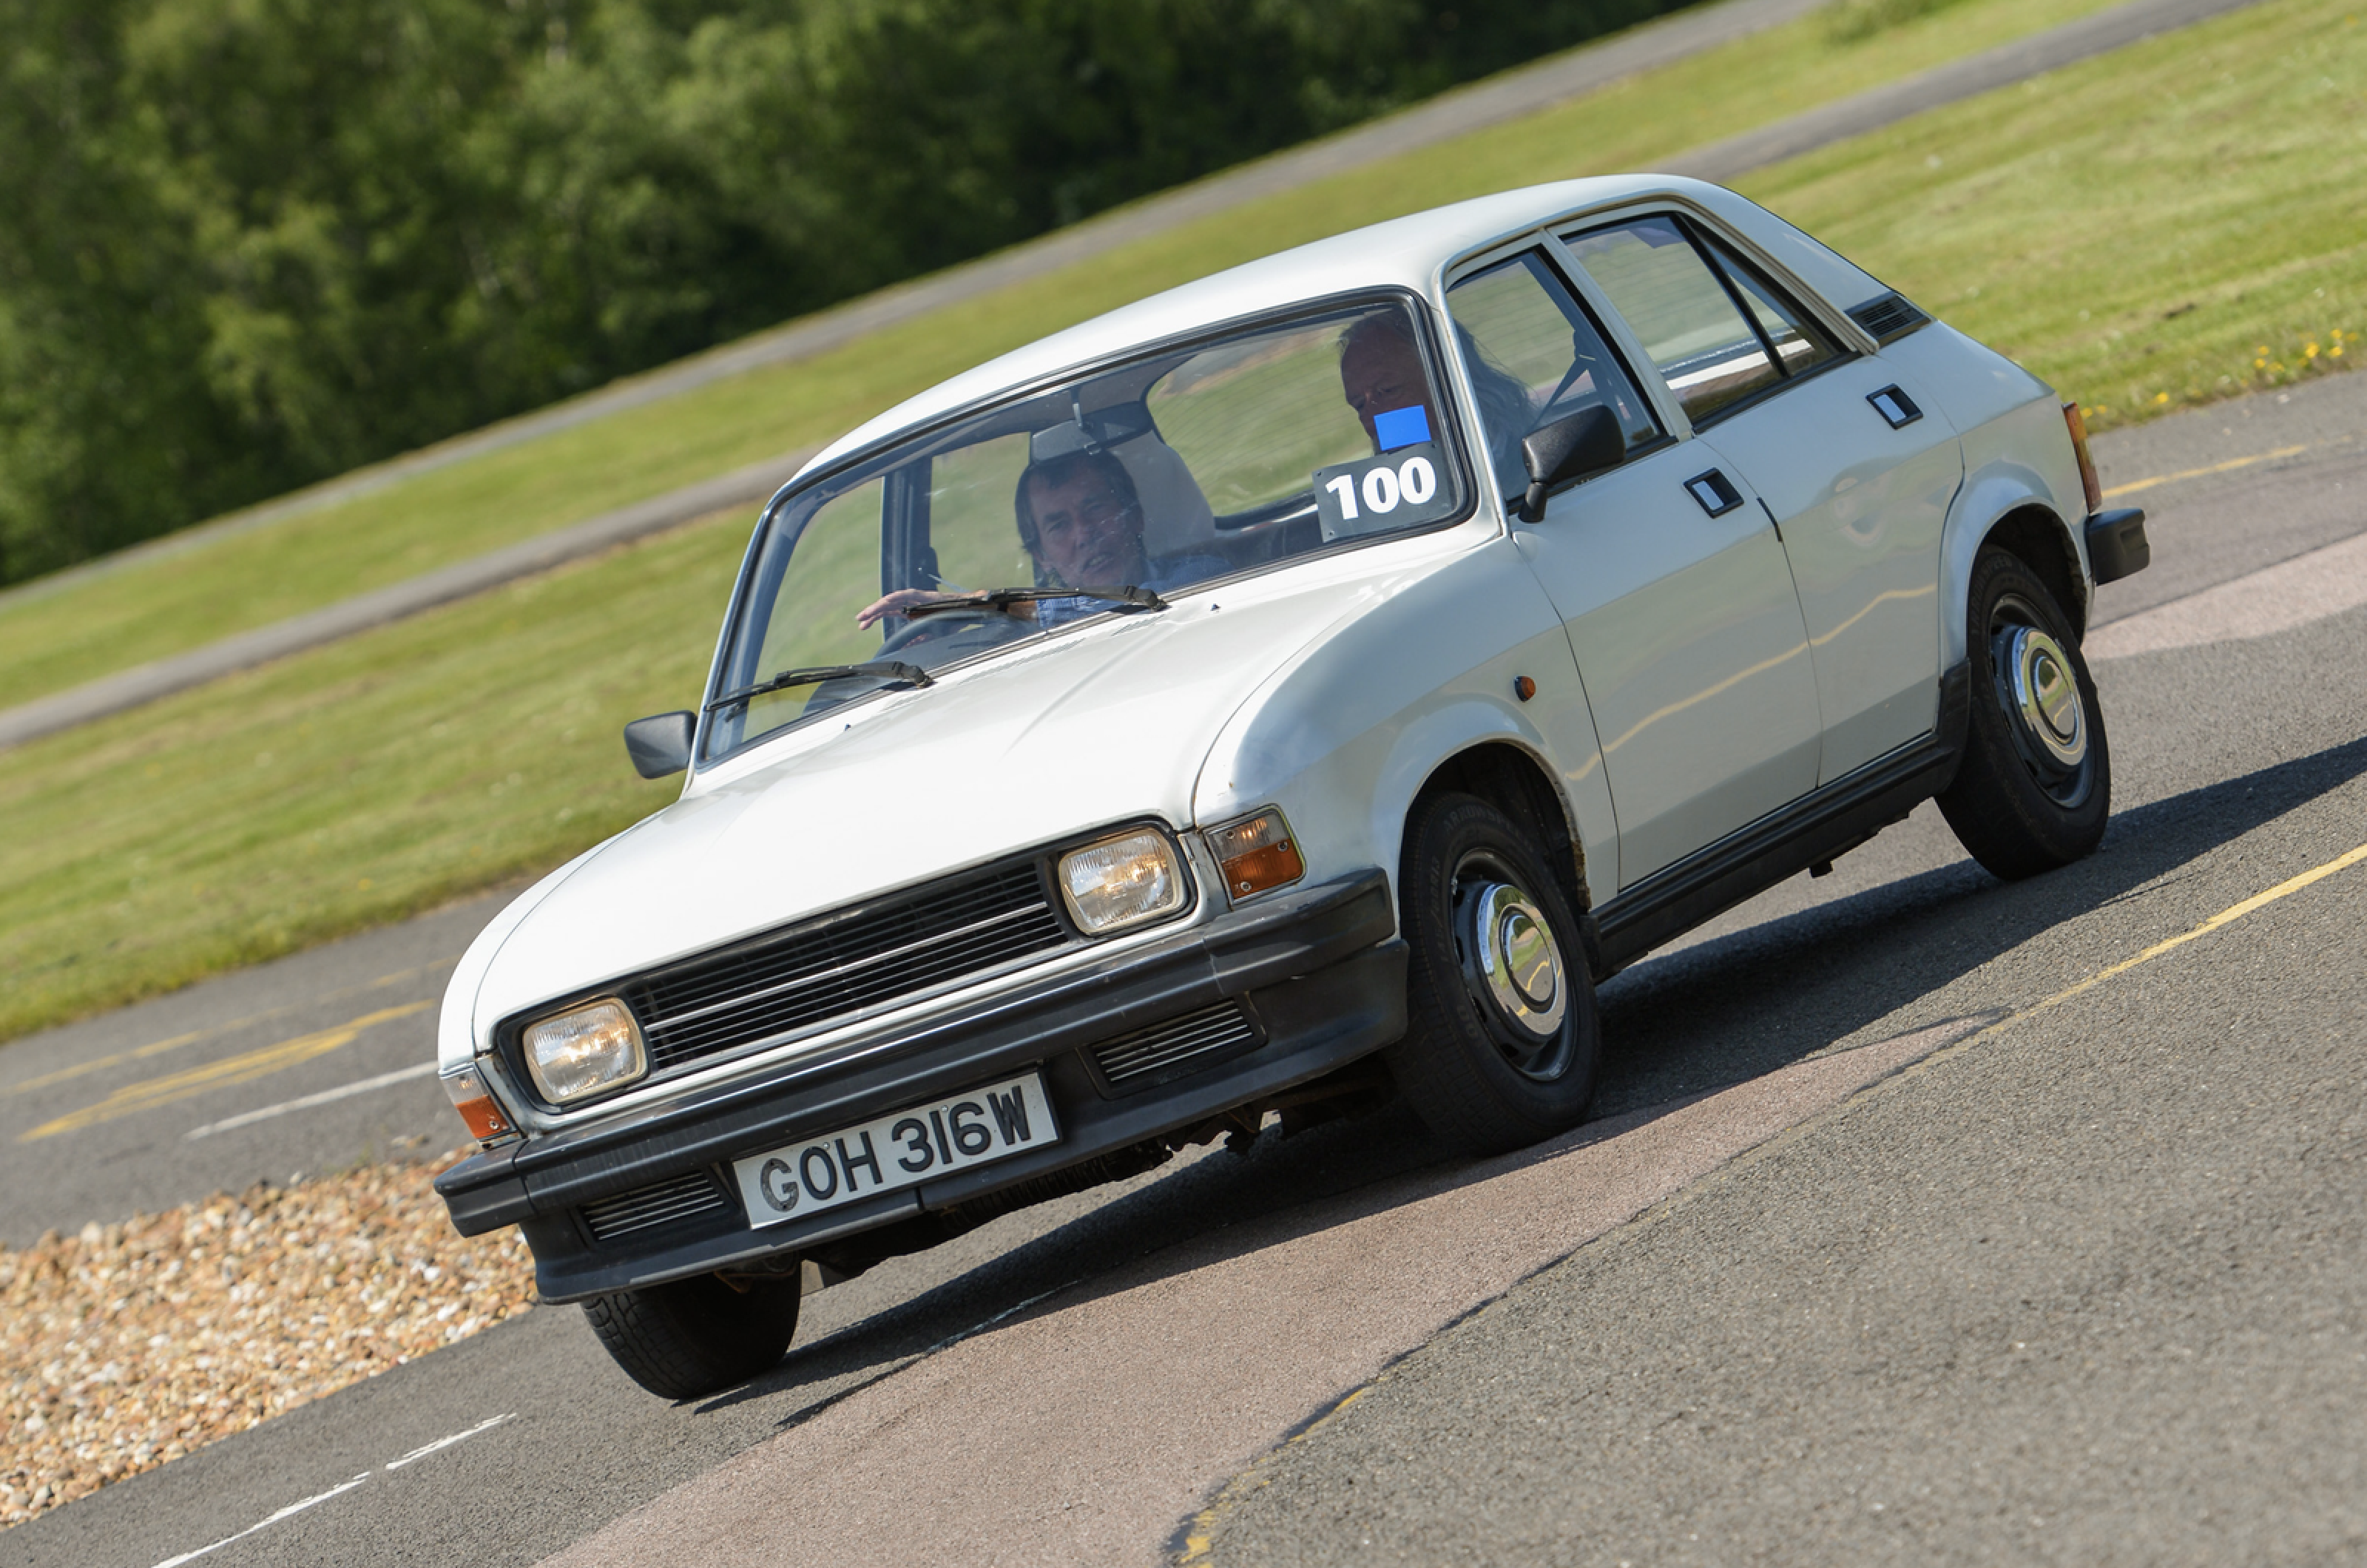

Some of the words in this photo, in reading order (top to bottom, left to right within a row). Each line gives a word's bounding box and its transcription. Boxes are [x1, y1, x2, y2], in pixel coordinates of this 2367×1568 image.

[1326, 456, 1436, 519] 100
[760, 1130, 883, 1212] GOH
[891, 1085, 1032, 1173] 316W
